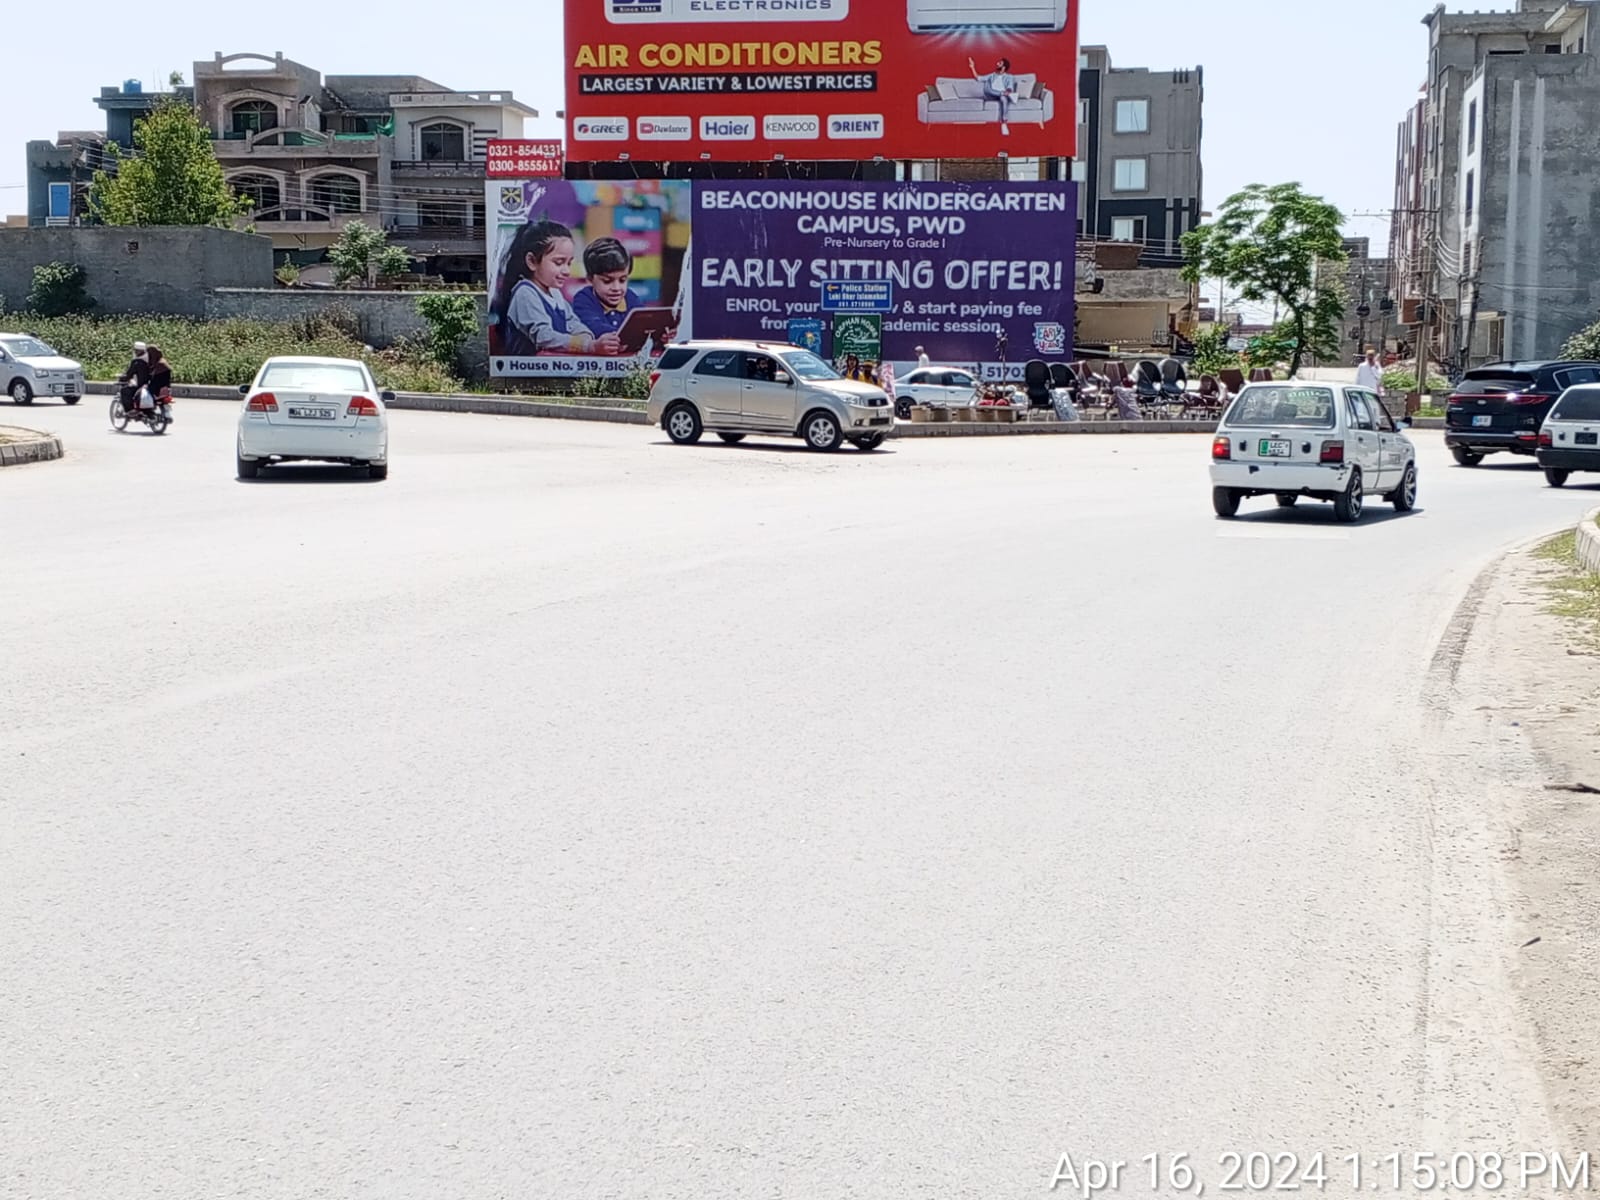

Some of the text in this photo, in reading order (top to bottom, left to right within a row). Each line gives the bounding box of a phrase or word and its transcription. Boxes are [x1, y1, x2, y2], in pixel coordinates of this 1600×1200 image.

[690, 0, 831, 11] ELECTRONICS
[574, 40, 882, 67] AIR CONDITIONERS
[583, 74, 872, 92] LARGEST VARIETY & LOWEST PRICES
[591, 124, 624, 134] GREE
[705, 120, 749, 136] Haier
[766, 121, 816, 133] KENWOOD
[832, 120, 879, 133] ORIENT
[701, 190, 1065, 211] BEACONHOUSE KINDERGARTEN
[797, 215, 966, 237] CAMPUS, PWD
[824, 236, 889, 250] Pre-Nursery
[893, 238, 904, 248] to
[907, 237, 939, 249] Grade
[702, 258, 1063, 291] EARLY SITTING OFFER!
[841, 284, 887, 292] Police Station
[726, 298, 781, 312] ENROL
[785, 302, 820, 315] your
[903, 301, 915, 314] &
[919, 302, 956, 315] start
[961, 302, 1013, 318] paying
[1018, 302, 1042, 315] fee
[510, 360, 548, 371] House
[552, 361, 573, 371] No.
[577, 361, 602, 373] 919,
